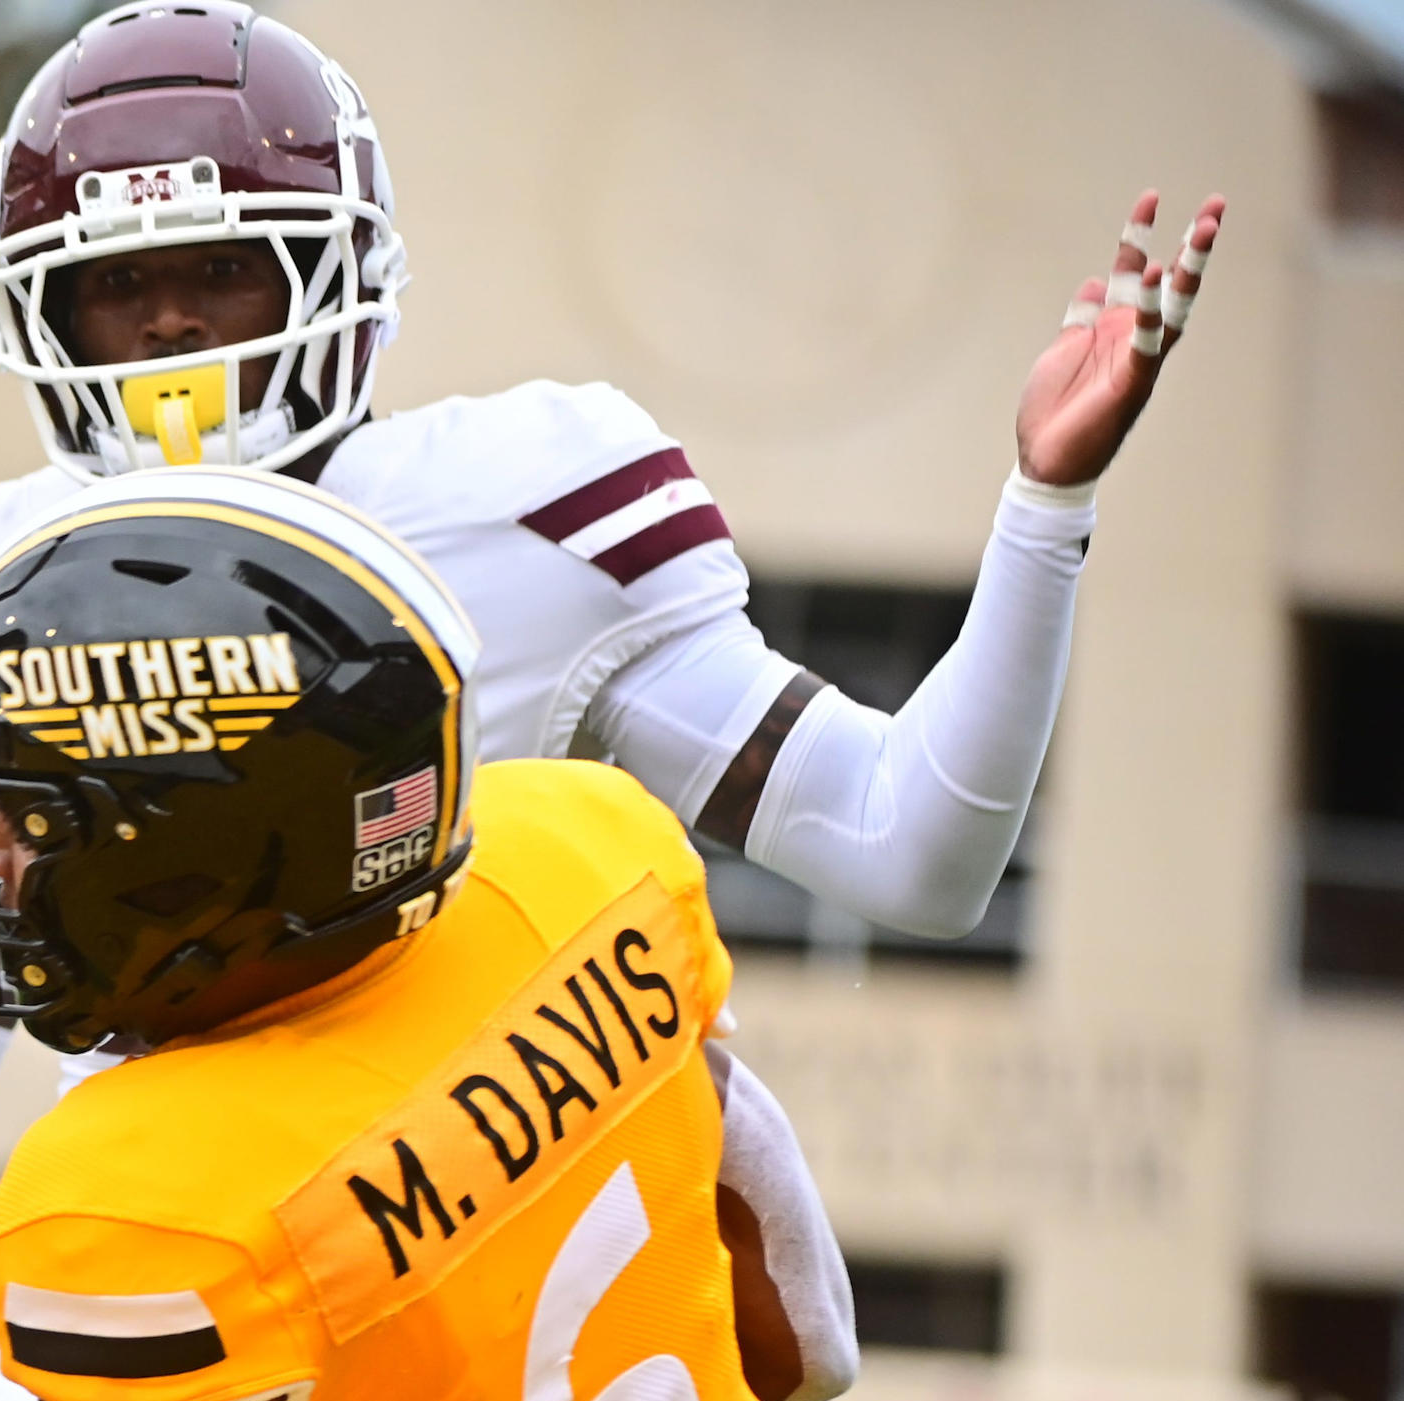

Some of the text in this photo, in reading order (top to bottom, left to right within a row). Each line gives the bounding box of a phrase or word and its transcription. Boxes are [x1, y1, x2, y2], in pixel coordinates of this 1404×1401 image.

[79, 699, 216, 758] MISS
[346, 1137, 477, 1279] M.
[450, 928, 679, 1184] DAVIS
